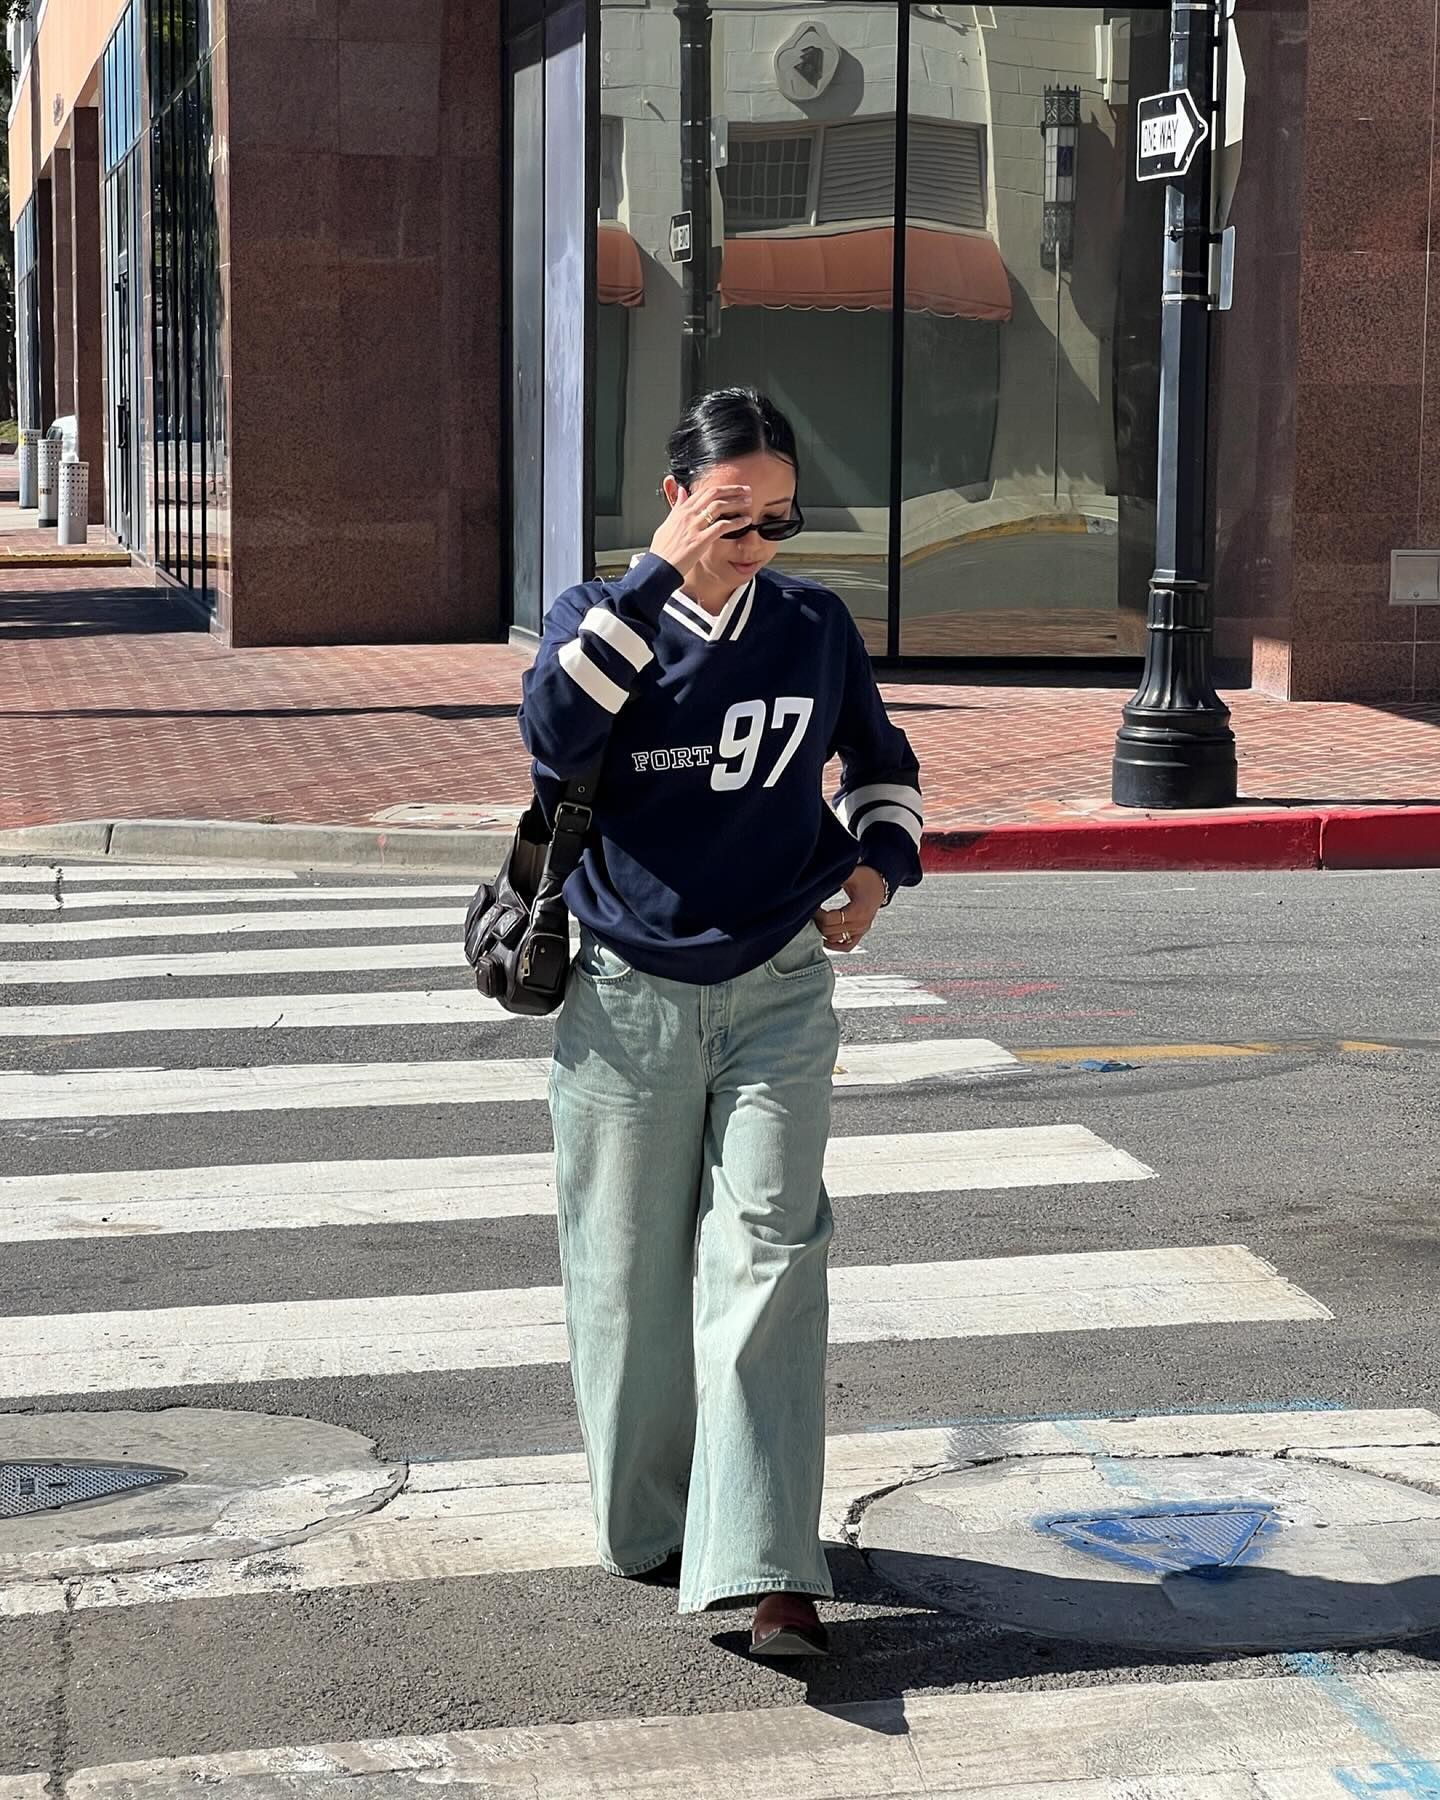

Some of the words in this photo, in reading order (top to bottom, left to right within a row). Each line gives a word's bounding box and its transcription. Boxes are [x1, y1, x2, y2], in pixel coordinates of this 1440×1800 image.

[1143, 122, 1158, 153] ONE
[1159, 118, 1179, 151] WAY
[632, 745, 713, 772] FORT
[710, 696, 815, 792] 97
